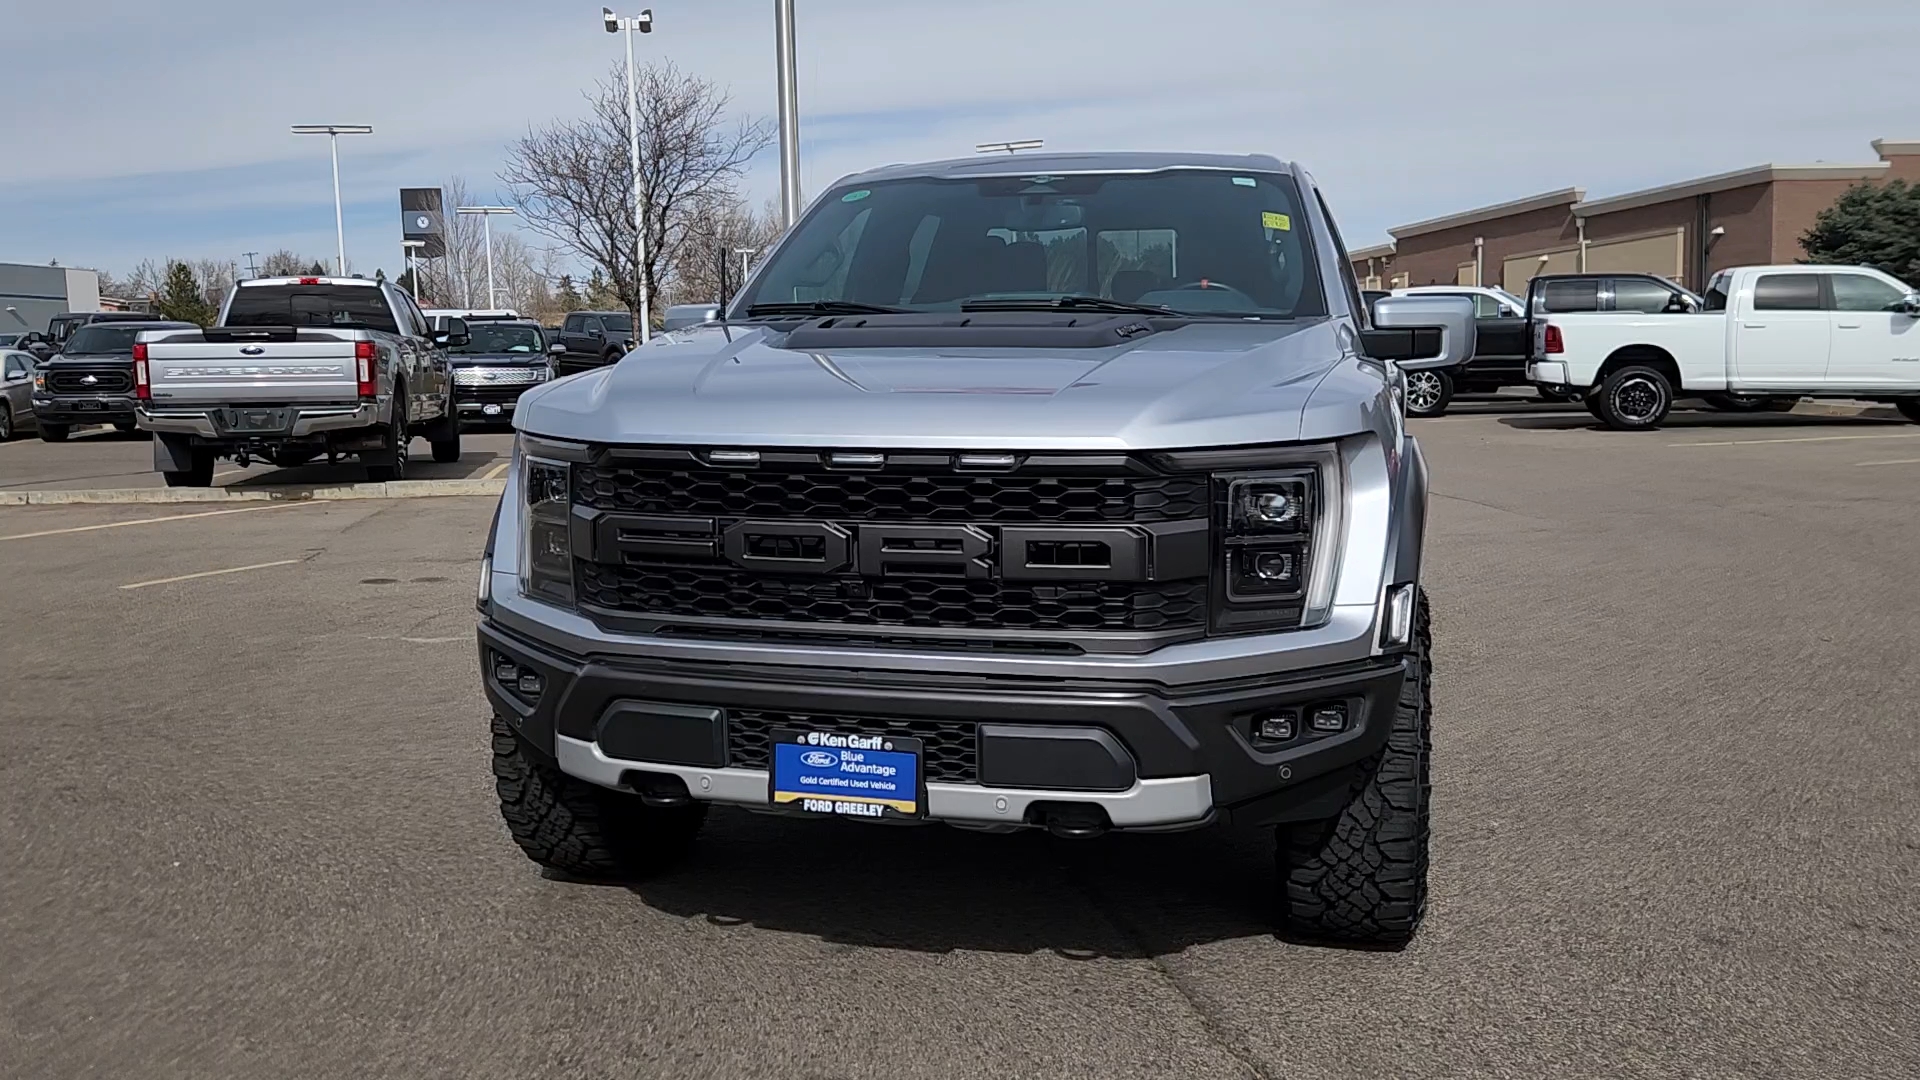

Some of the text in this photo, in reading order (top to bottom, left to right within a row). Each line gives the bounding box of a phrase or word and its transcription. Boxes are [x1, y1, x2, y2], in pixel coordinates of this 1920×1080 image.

[166, 365, 341, 376] SUPER DUTY
[597, 514, 1148, 583] FORD
[820, 733, 883, 750] Ken Garff
[806, 753, 832, 765] Ford
[840, 751, 864, 762] Blue
[840, 762, 897, 776] Advantage
[800, 776, 896, 790] Gold Certified Used Vehicle
[803, 799, 884, 817] FORD GREELEY
